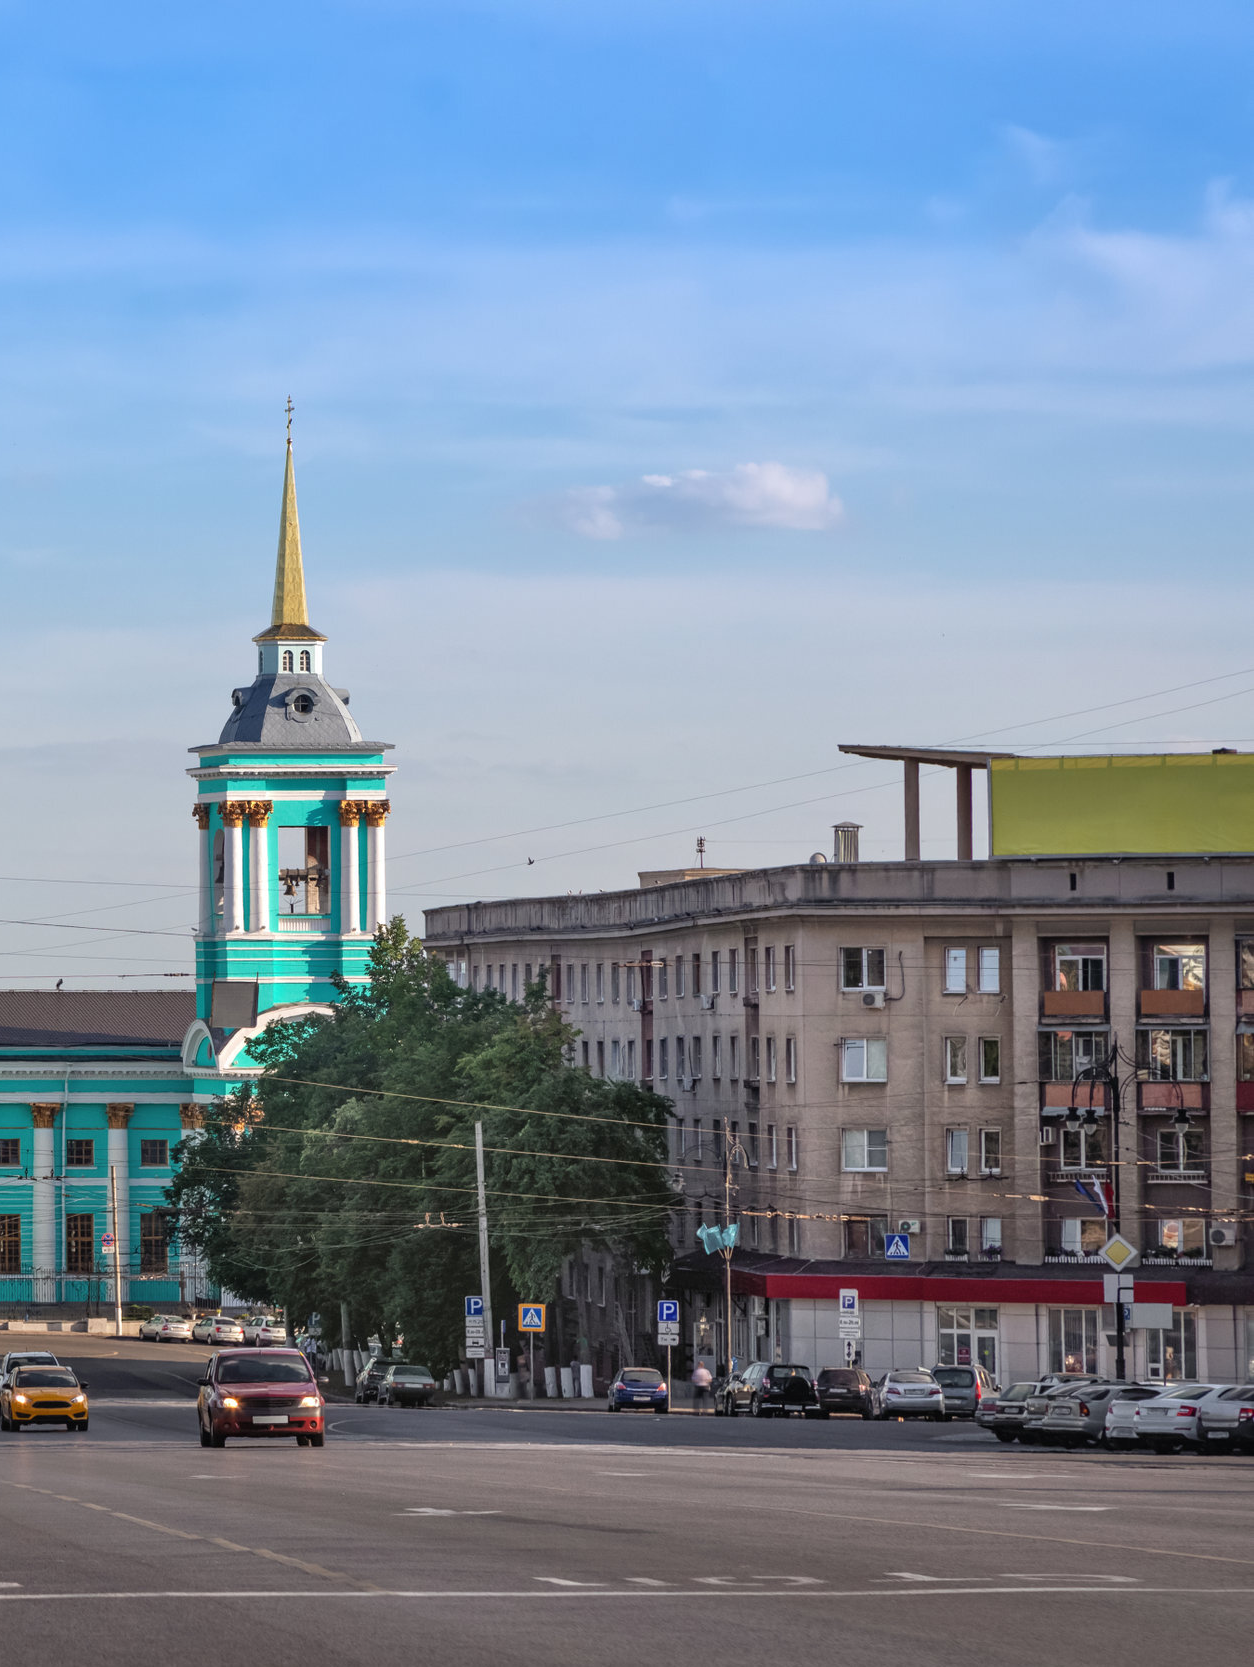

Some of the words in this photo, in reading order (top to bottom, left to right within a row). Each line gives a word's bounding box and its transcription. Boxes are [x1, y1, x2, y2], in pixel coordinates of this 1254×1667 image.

[471, 1298, 482, 1314] P
[845, 1297, 853, 1307] P
[663, 1303, 675, 1320] P
